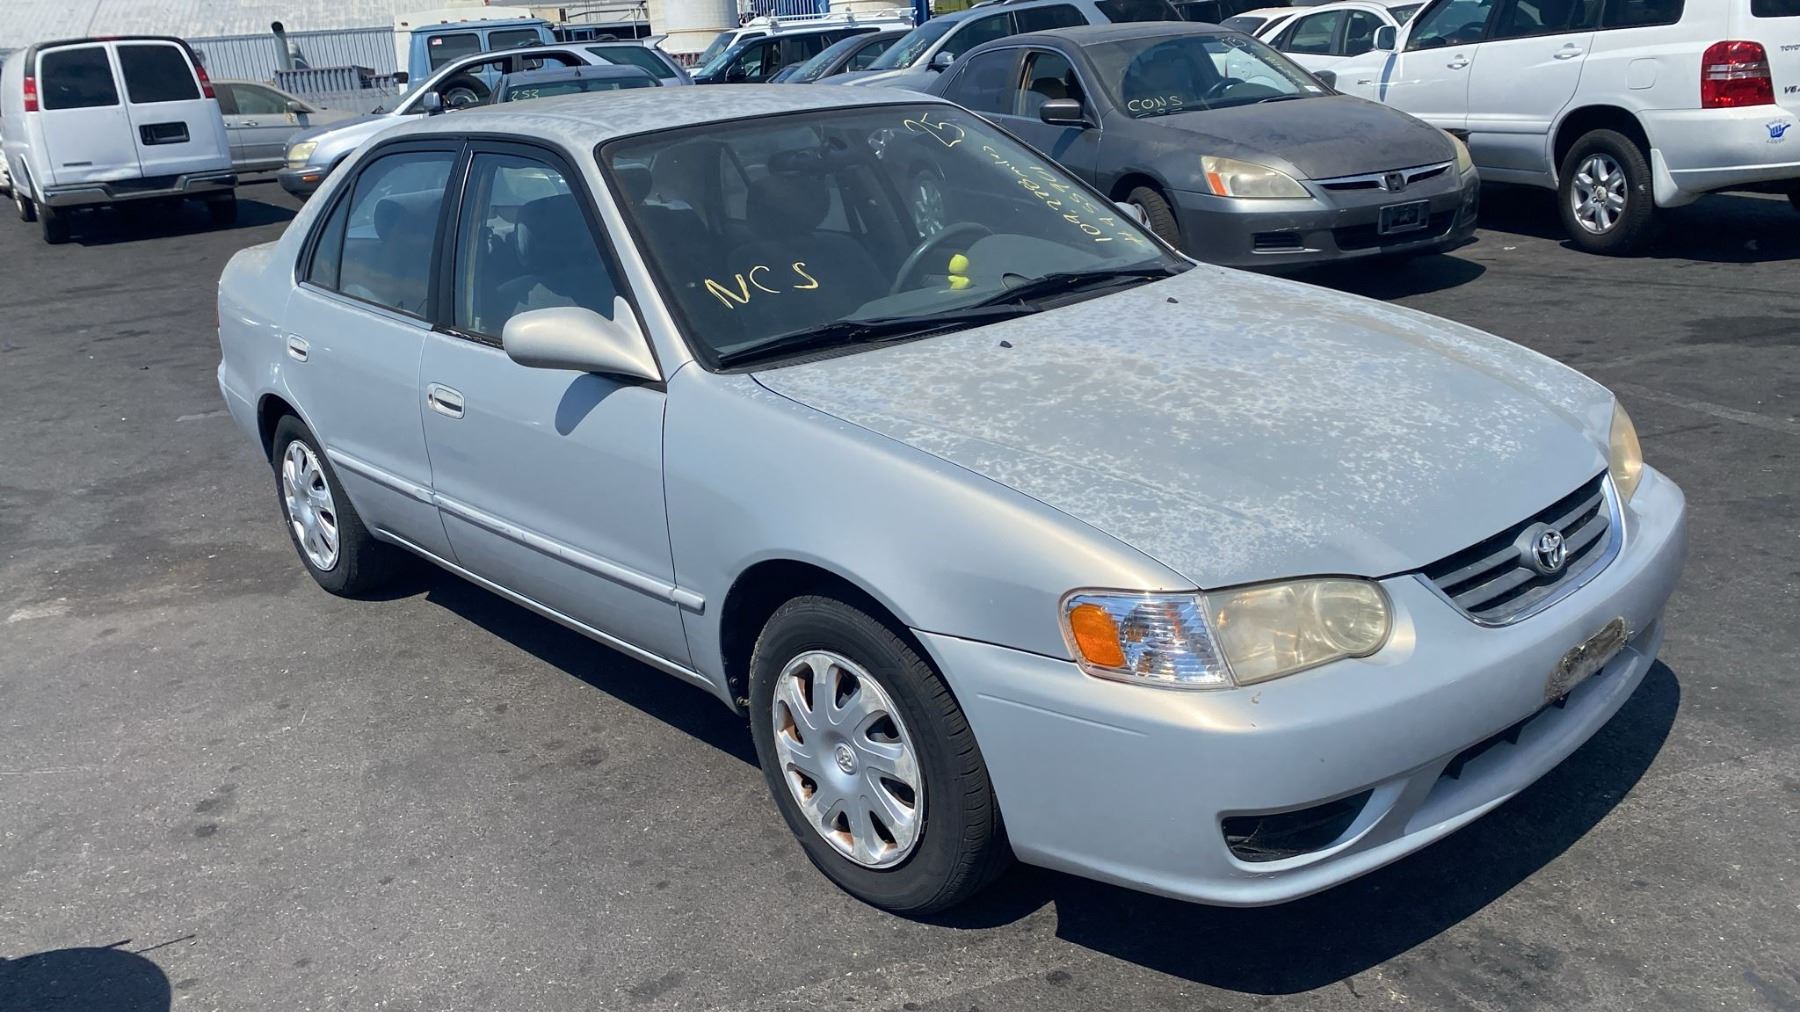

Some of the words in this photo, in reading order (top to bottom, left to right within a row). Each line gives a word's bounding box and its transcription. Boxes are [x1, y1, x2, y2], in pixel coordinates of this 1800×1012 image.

[1127, 95, 1183, 111] CONS
[903, 112, 965, 148] 25
[704, 262, 819, 309] NCS
